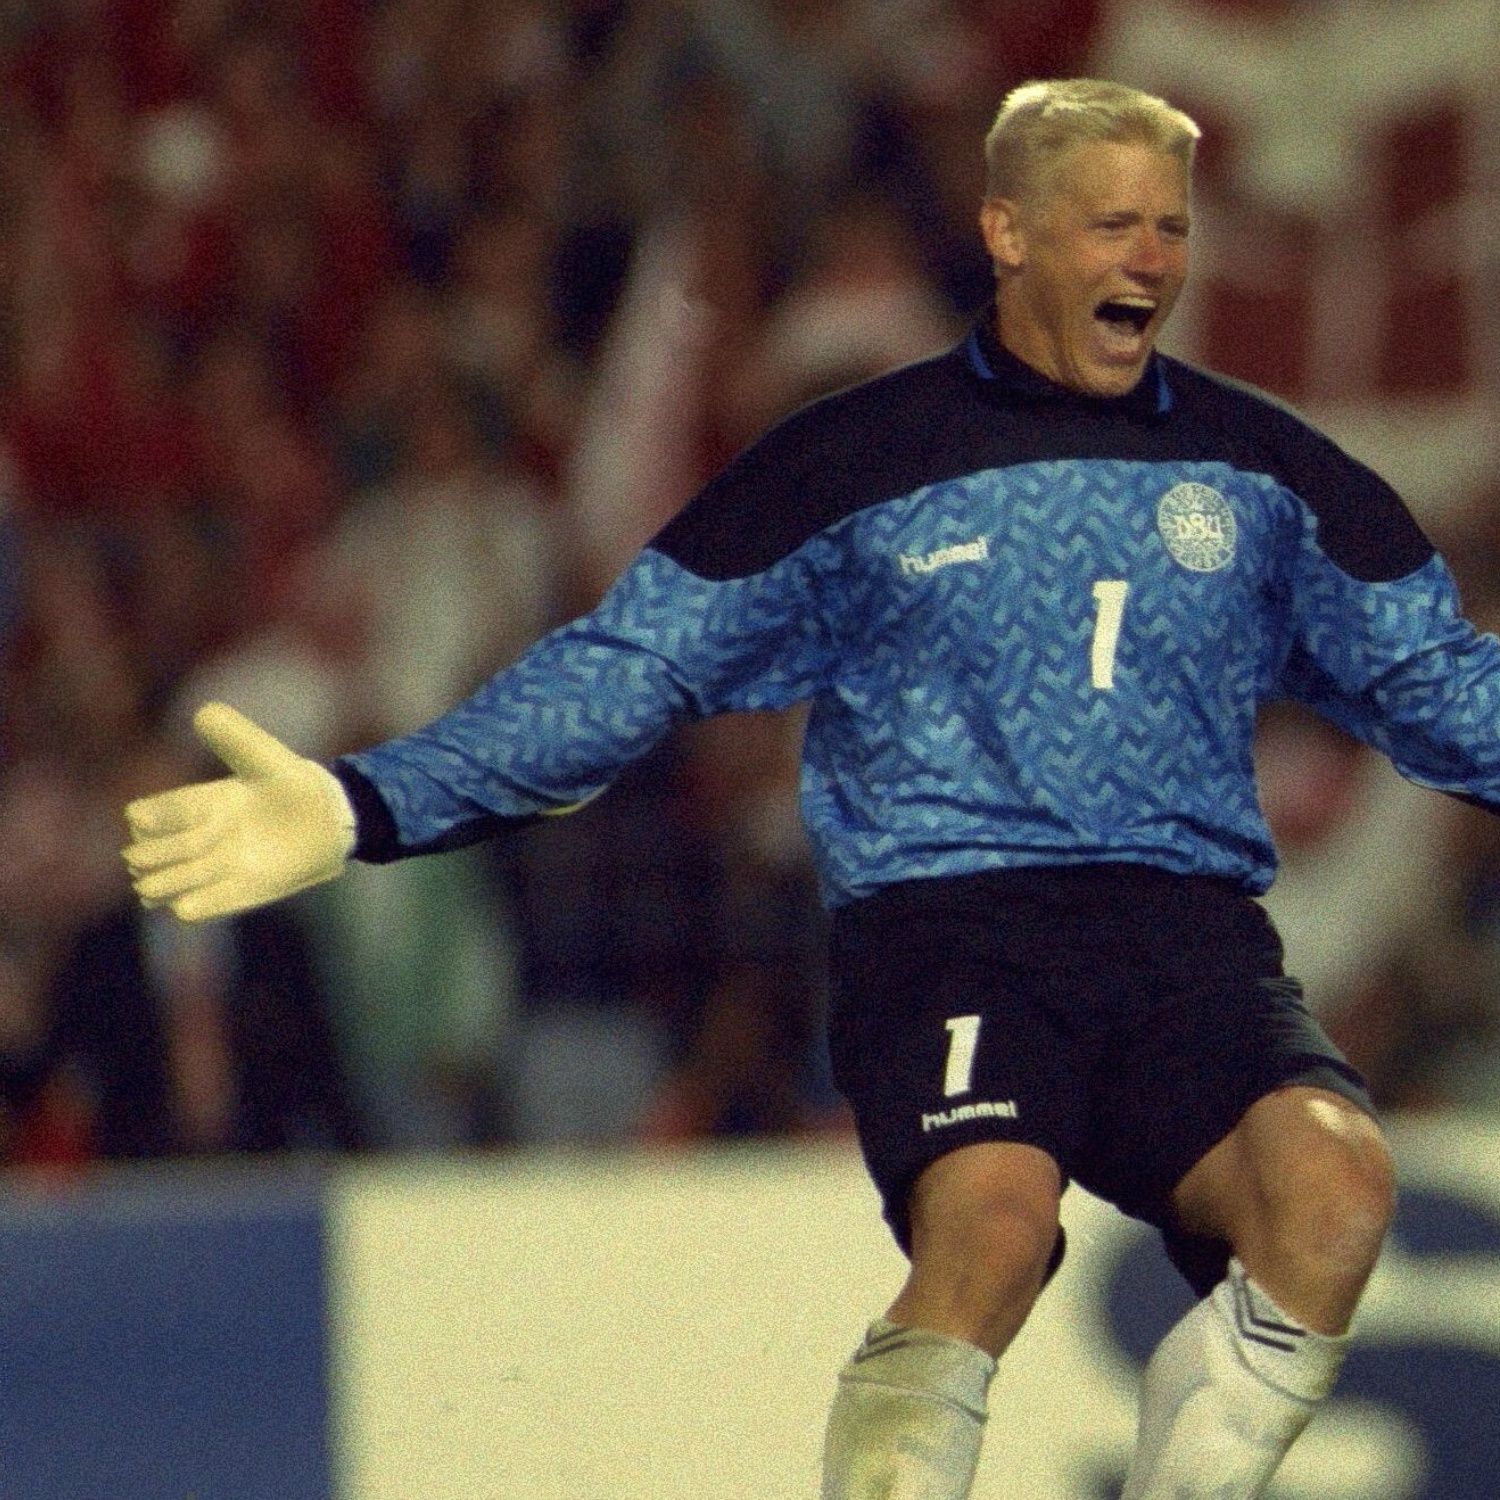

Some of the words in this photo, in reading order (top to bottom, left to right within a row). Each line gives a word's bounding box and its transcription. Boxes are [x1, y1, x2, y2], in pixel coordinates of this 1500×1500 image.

[899, 535, 988, 576] hummel
[1092, 580, 1128, 690] 1
[944, 1015, 981, 1097] 1
[922, 1100, 1018, 1132] hummel
